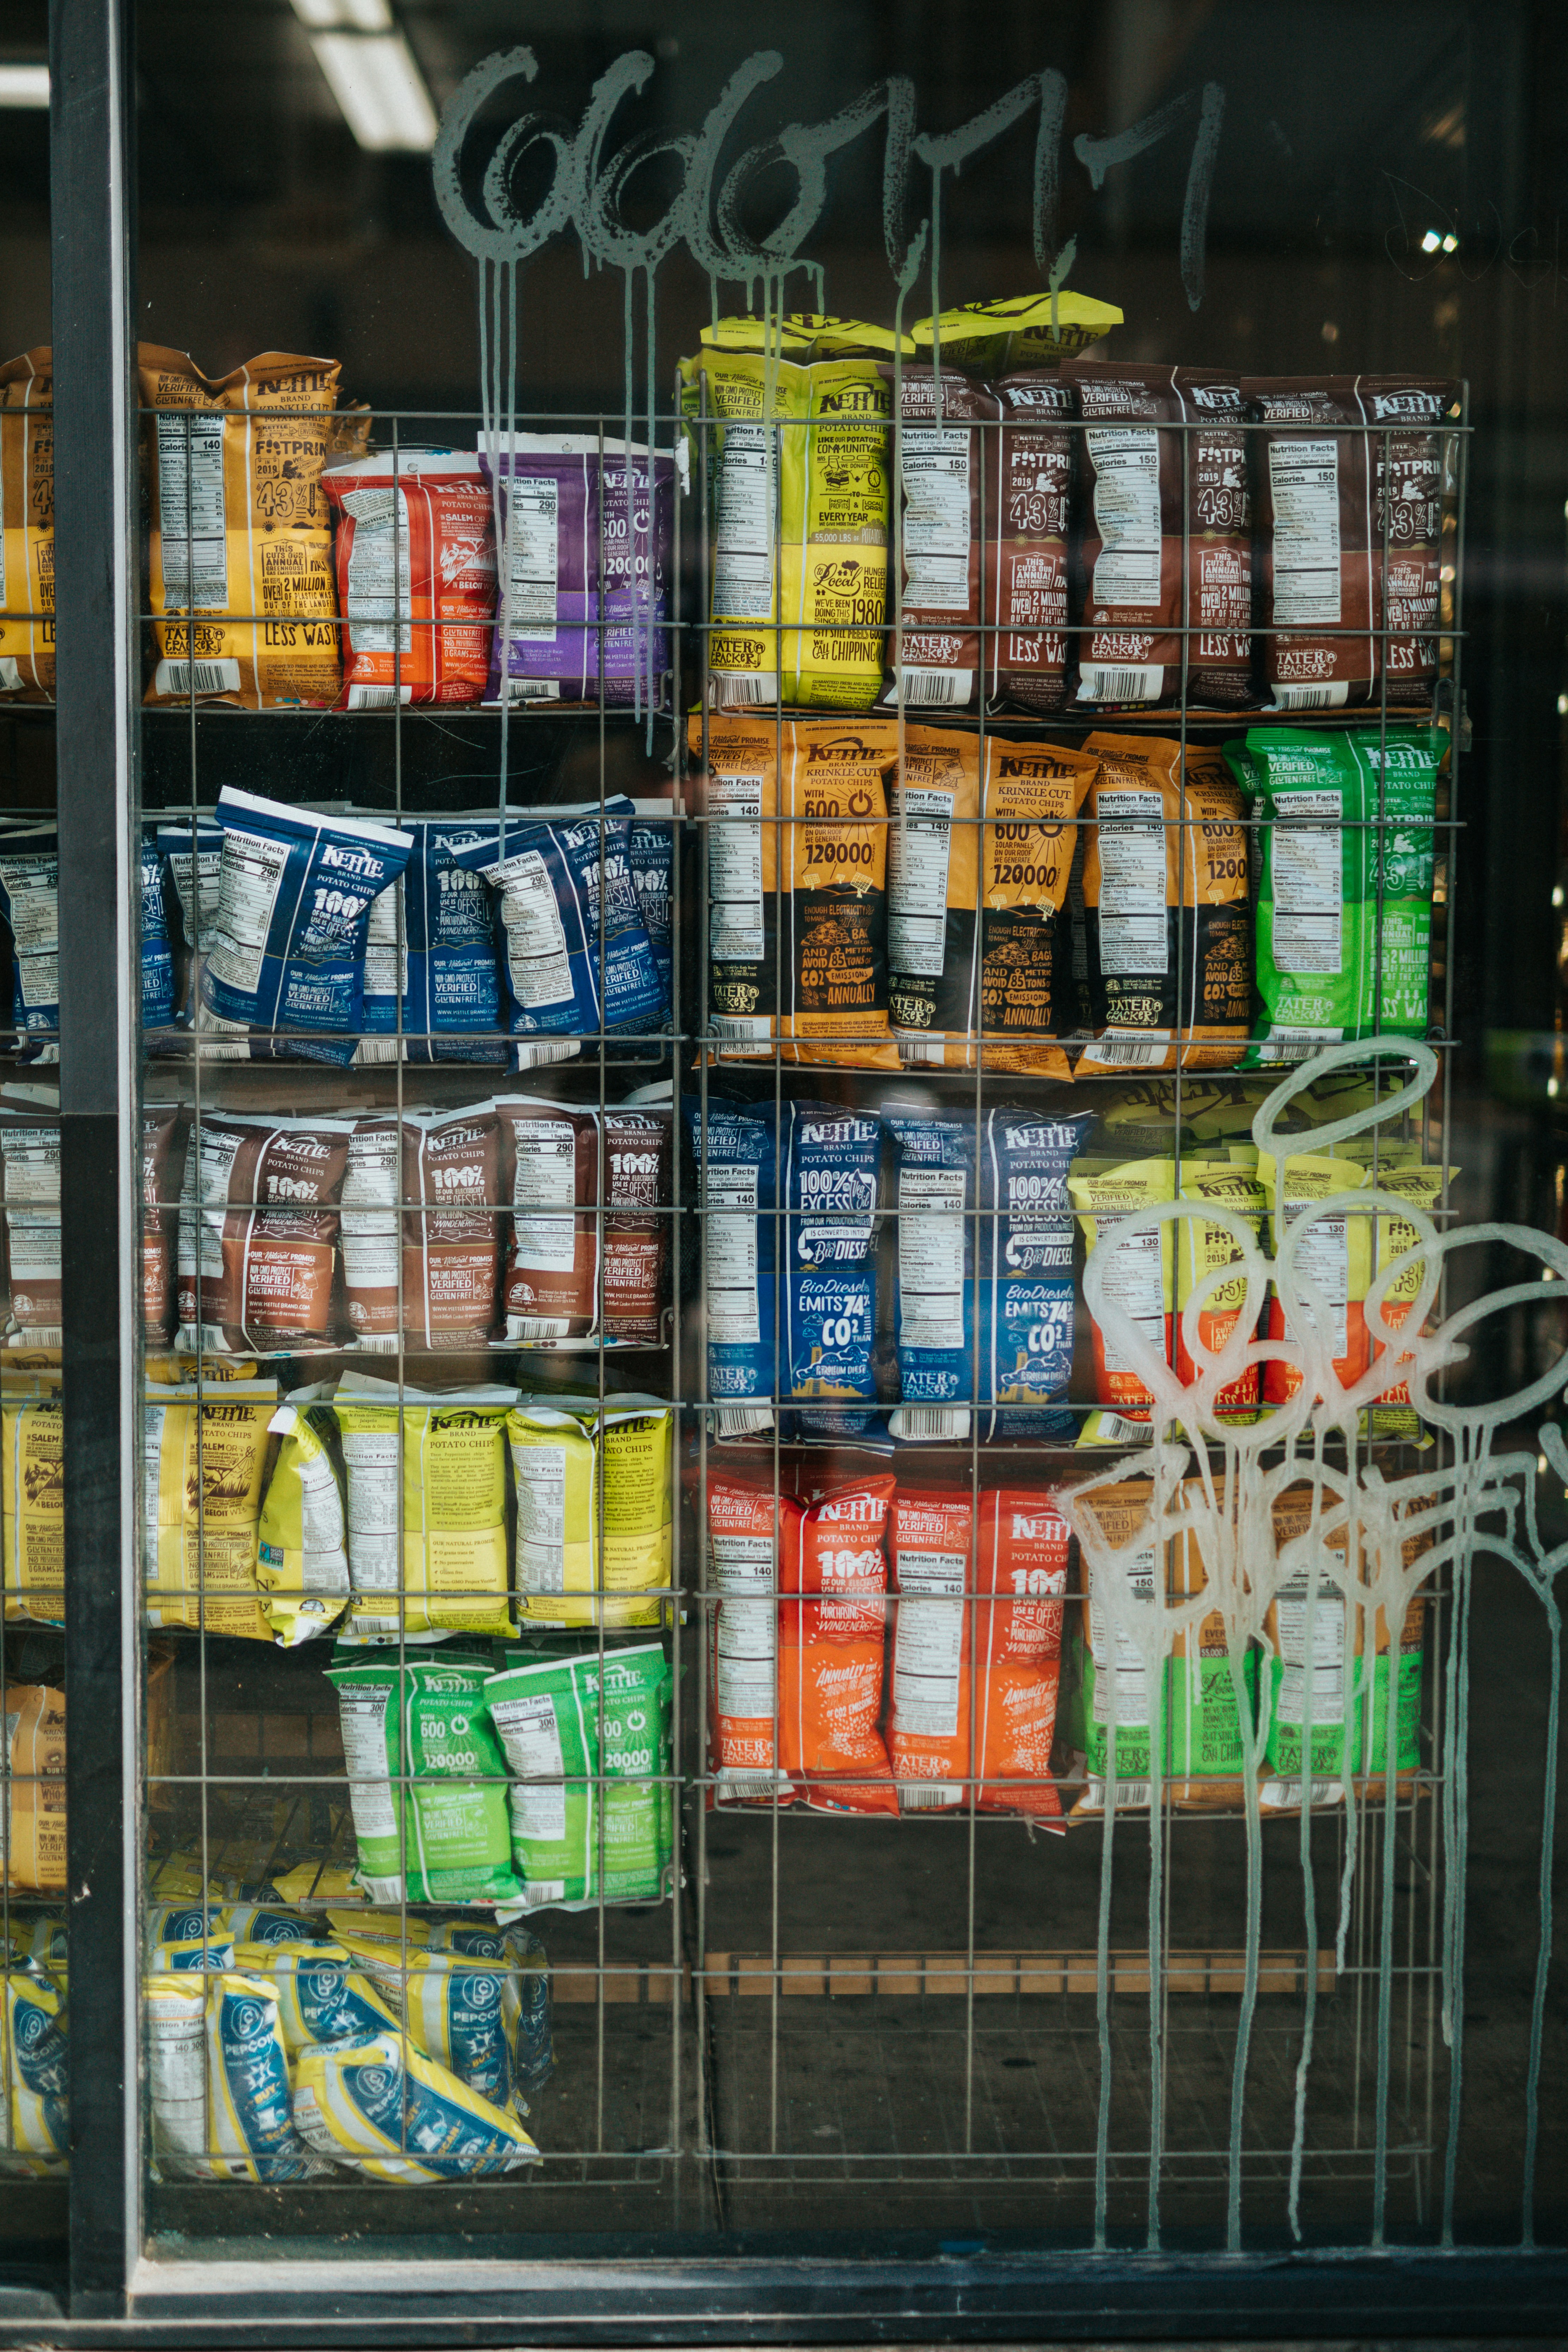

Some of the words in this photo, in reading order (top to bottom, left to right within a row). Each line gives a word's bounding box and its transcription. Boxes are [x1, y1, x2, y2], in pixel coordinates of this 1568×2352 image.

[730, 373, 758, 385] Natural
[715, 385, 736, 395] NON-GMO
[738, 389, 761, 398] PROJECT
[715, 395, 761, 406] VERIFIED
[1082, 393, 1128, 403] VERIFIED
[718, 407, 742, 417] GLUTEN
[743, 408, 759, 417] FREE
[1082, 405, 1111, 416] GLUTEN
[1113, 405, 1130, 414] FREE
[1264, 407, 1309, 419] VERIFIED
[944, 432, 968, 440] Facts
[1089, 430, 1128, 439] Nutrition
[203, 440, 220, 450] 140
[949, 460, 966, 470] 150
[1139, 455, 1157, 465] 150
[257, 465, 277, 474] 2019
[1012, 478, 1031, 486] 2019
[1273, 475, 1305, 483] Calories
[1317, 471, 1335, 482] 150
[539, 500, 556, 510] 290
[819, 512, 846, 521] EVERY
[846, 513, 868, 521] YEAR
[815, 533, 837, 543] 55,000
[839, 533, 851, 542] LBS
[861, 528, 883, 543] POTATOES
[284, 578, 290, 591] 2
[292, 577, 325, 592] MILLION
[815, 609, 835, 618] DOING
[265, 623, 296, 646] LESS
[443, 629, 466, 637] GLUTEN
[712, 640, 754, 653] TATER
[831, 640, 875, 662] CHIPPING
[1276, 652, 1325, 663] TATER
[807, 737, 886, 763] KETTLE
[1269, 760, 1314, 771] VERIFIED
[807, 767, 854, 776] KRINKLE
[1298, 774, 1316, 783] FREE
[804, 789, 824, 798] WITH
[1099, 794, 1136, 803] Nutrition
[1139, 794, 1161, 802] Facts
[740, 806, 759, 815] 140
[261, 867, 278, 879] 290
[530, 874, 547, 885] 290
[804, 906, 828, 914] ENOUGH
[829, 904, 865, 915] ELECTRICITY
[803, 948, 827, 957] AND
[803, 958, 827, 968] AVOID
[832, 955, 844, 966] 85
[847, 955, 865, 966] TONS
[435, 973, 454, 983] NON-GMO
[456, 973, 476, 982] PROJECT
[801, 970, 824, 986] CO2
[435, 983, 477, 992] VERIFIED
[827, 984, 875, 1004] ANNUALLY
[1003, 1008, 1052, 1026] ANNUALLY
[800, 1118, 879, 1143] KETTLE
[556, 1143, 573, 1153] 290
[218, 1151, 233, 1163] 290
[801, 1155, 841, 1163] POTATO
[736, 1194, 754, 1204] 140
[943, 1199, 961, 1209] 140
[800, 1217, 814, 1226] FROM
[1142, 1238, 1159, 1246] 130
[264, 1251, 289, 1260] Natural
[291, 1254, 316, 1262] PROMISE
[431, 1279, 471, 1289] VERIFIED
[799, 1296, 842, 1311] EMITS
[431, 1411, 501, 1433] KETTLE
[469, 1440, 495, 1448] CHIPS
[205, 1508, 228, 1517] BELOIT
[898, 1520, 943, 1532] VERIFIED
[925, 1535, 942, 1544] FREE
[944, 1583, 962, 1594] 140
[370, 1703, 384, 1713] 300
[421, 1721, 445, 1738] 600
